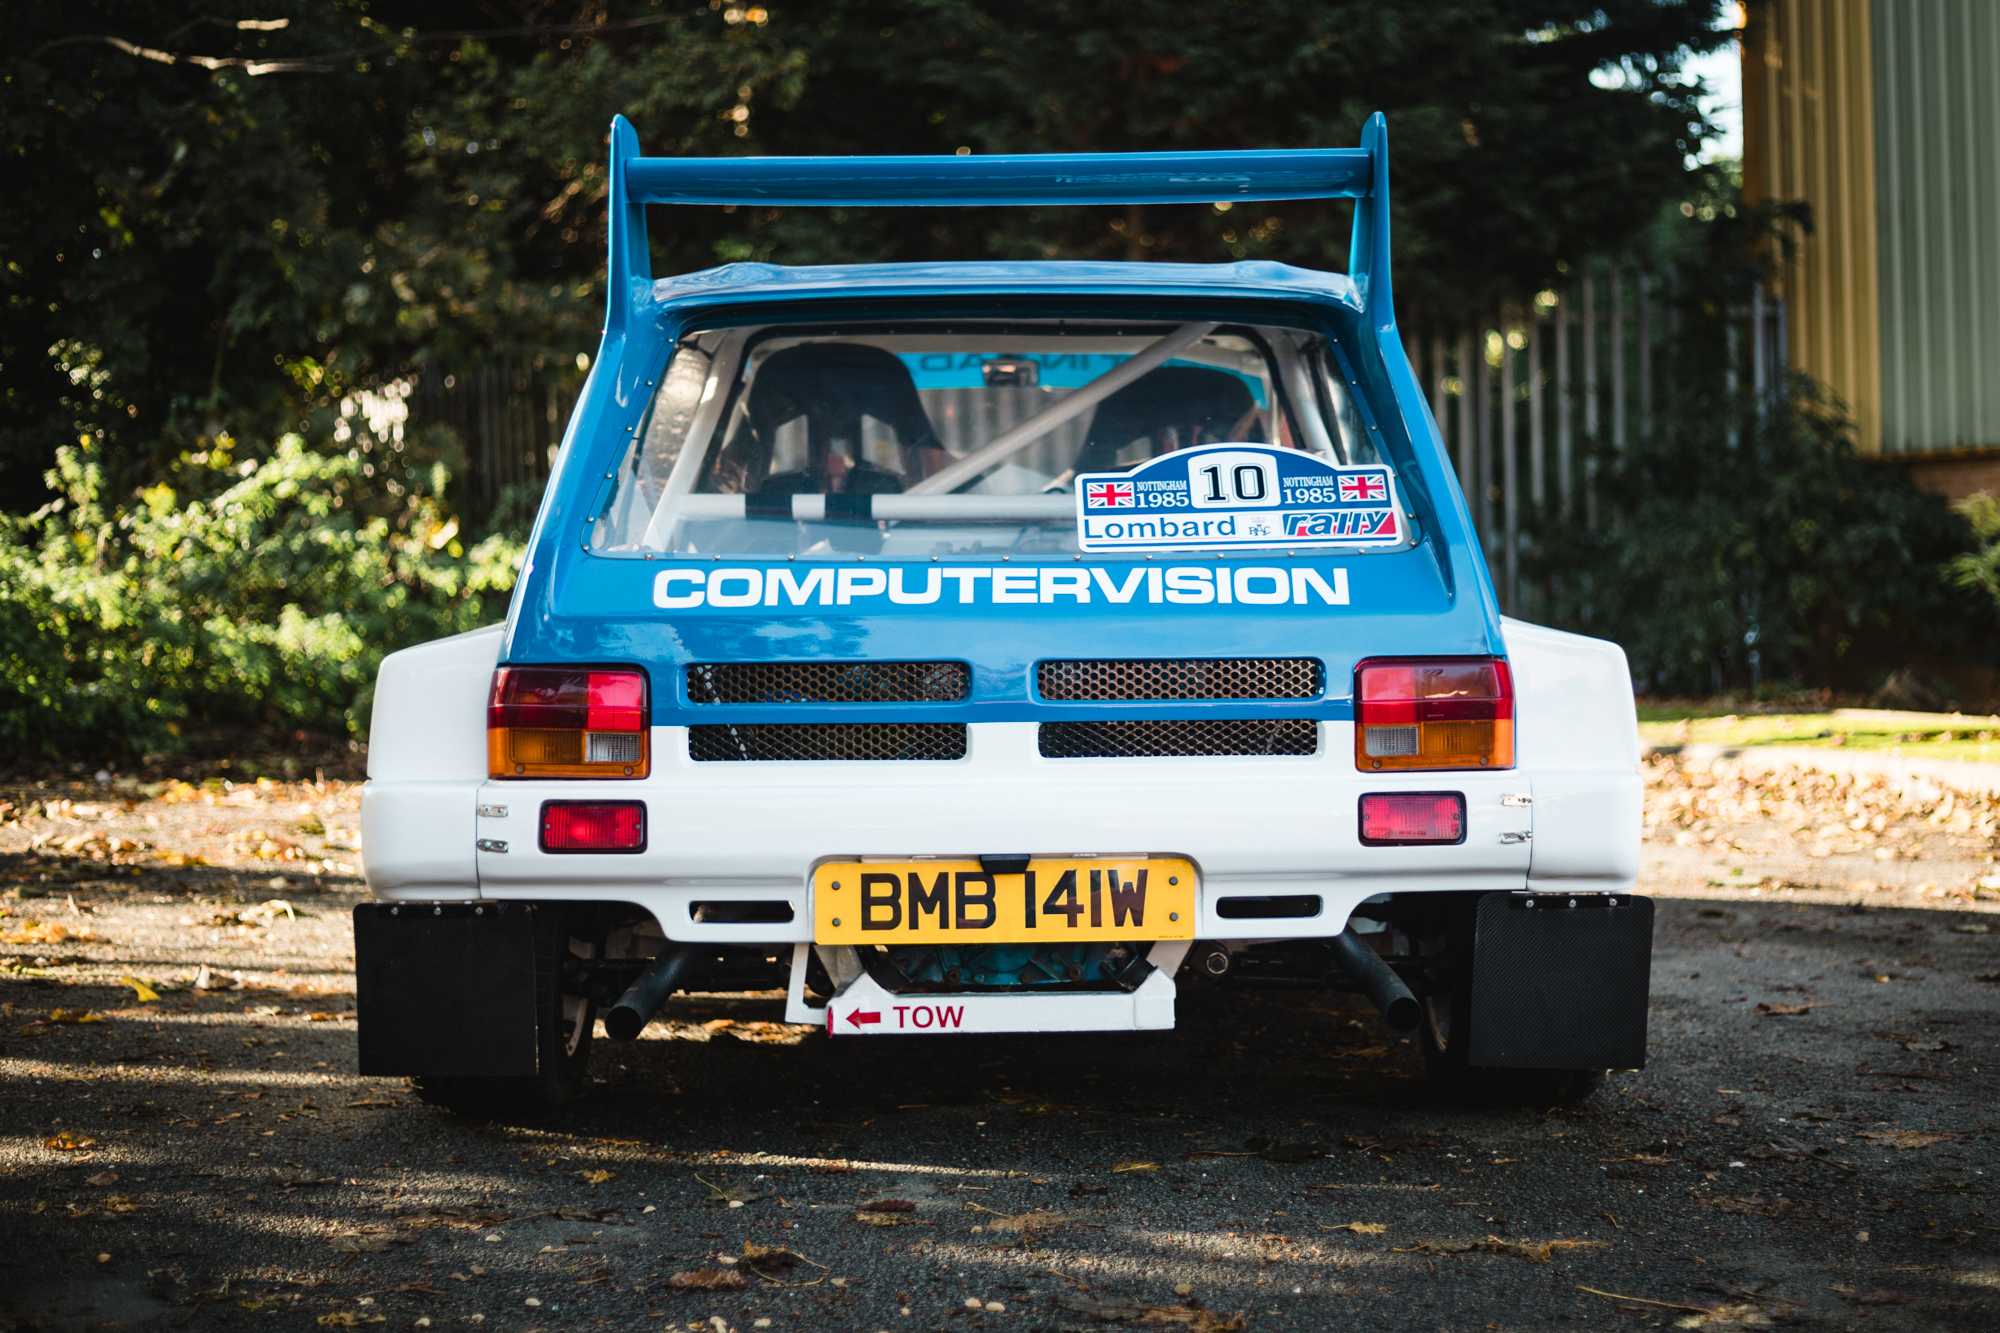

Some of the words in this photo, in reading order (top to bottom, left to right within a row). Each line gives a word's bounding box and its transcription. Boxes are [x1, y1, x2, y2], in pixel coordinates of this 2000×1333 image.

[1136, 480, 1188, 492] NOTTINGHAM
[1200, 464, 1269, 503] 10
[1283, 475, 1333, 488] NOTTINGHAM
[1136, 492, 1190, 508] 1985
[1283, 488, 1337, 504] 1985
[1084, 515, 1237, 539] Lombard
[1286, 511, 1391, 537] rally
[652, 566, 1351, 610] COMPUTERVISION
[860, 870, 997, 931] BMB
[1023, 868, 1149, 930] 141W
[892, 1005, 965, 1029] TOW
